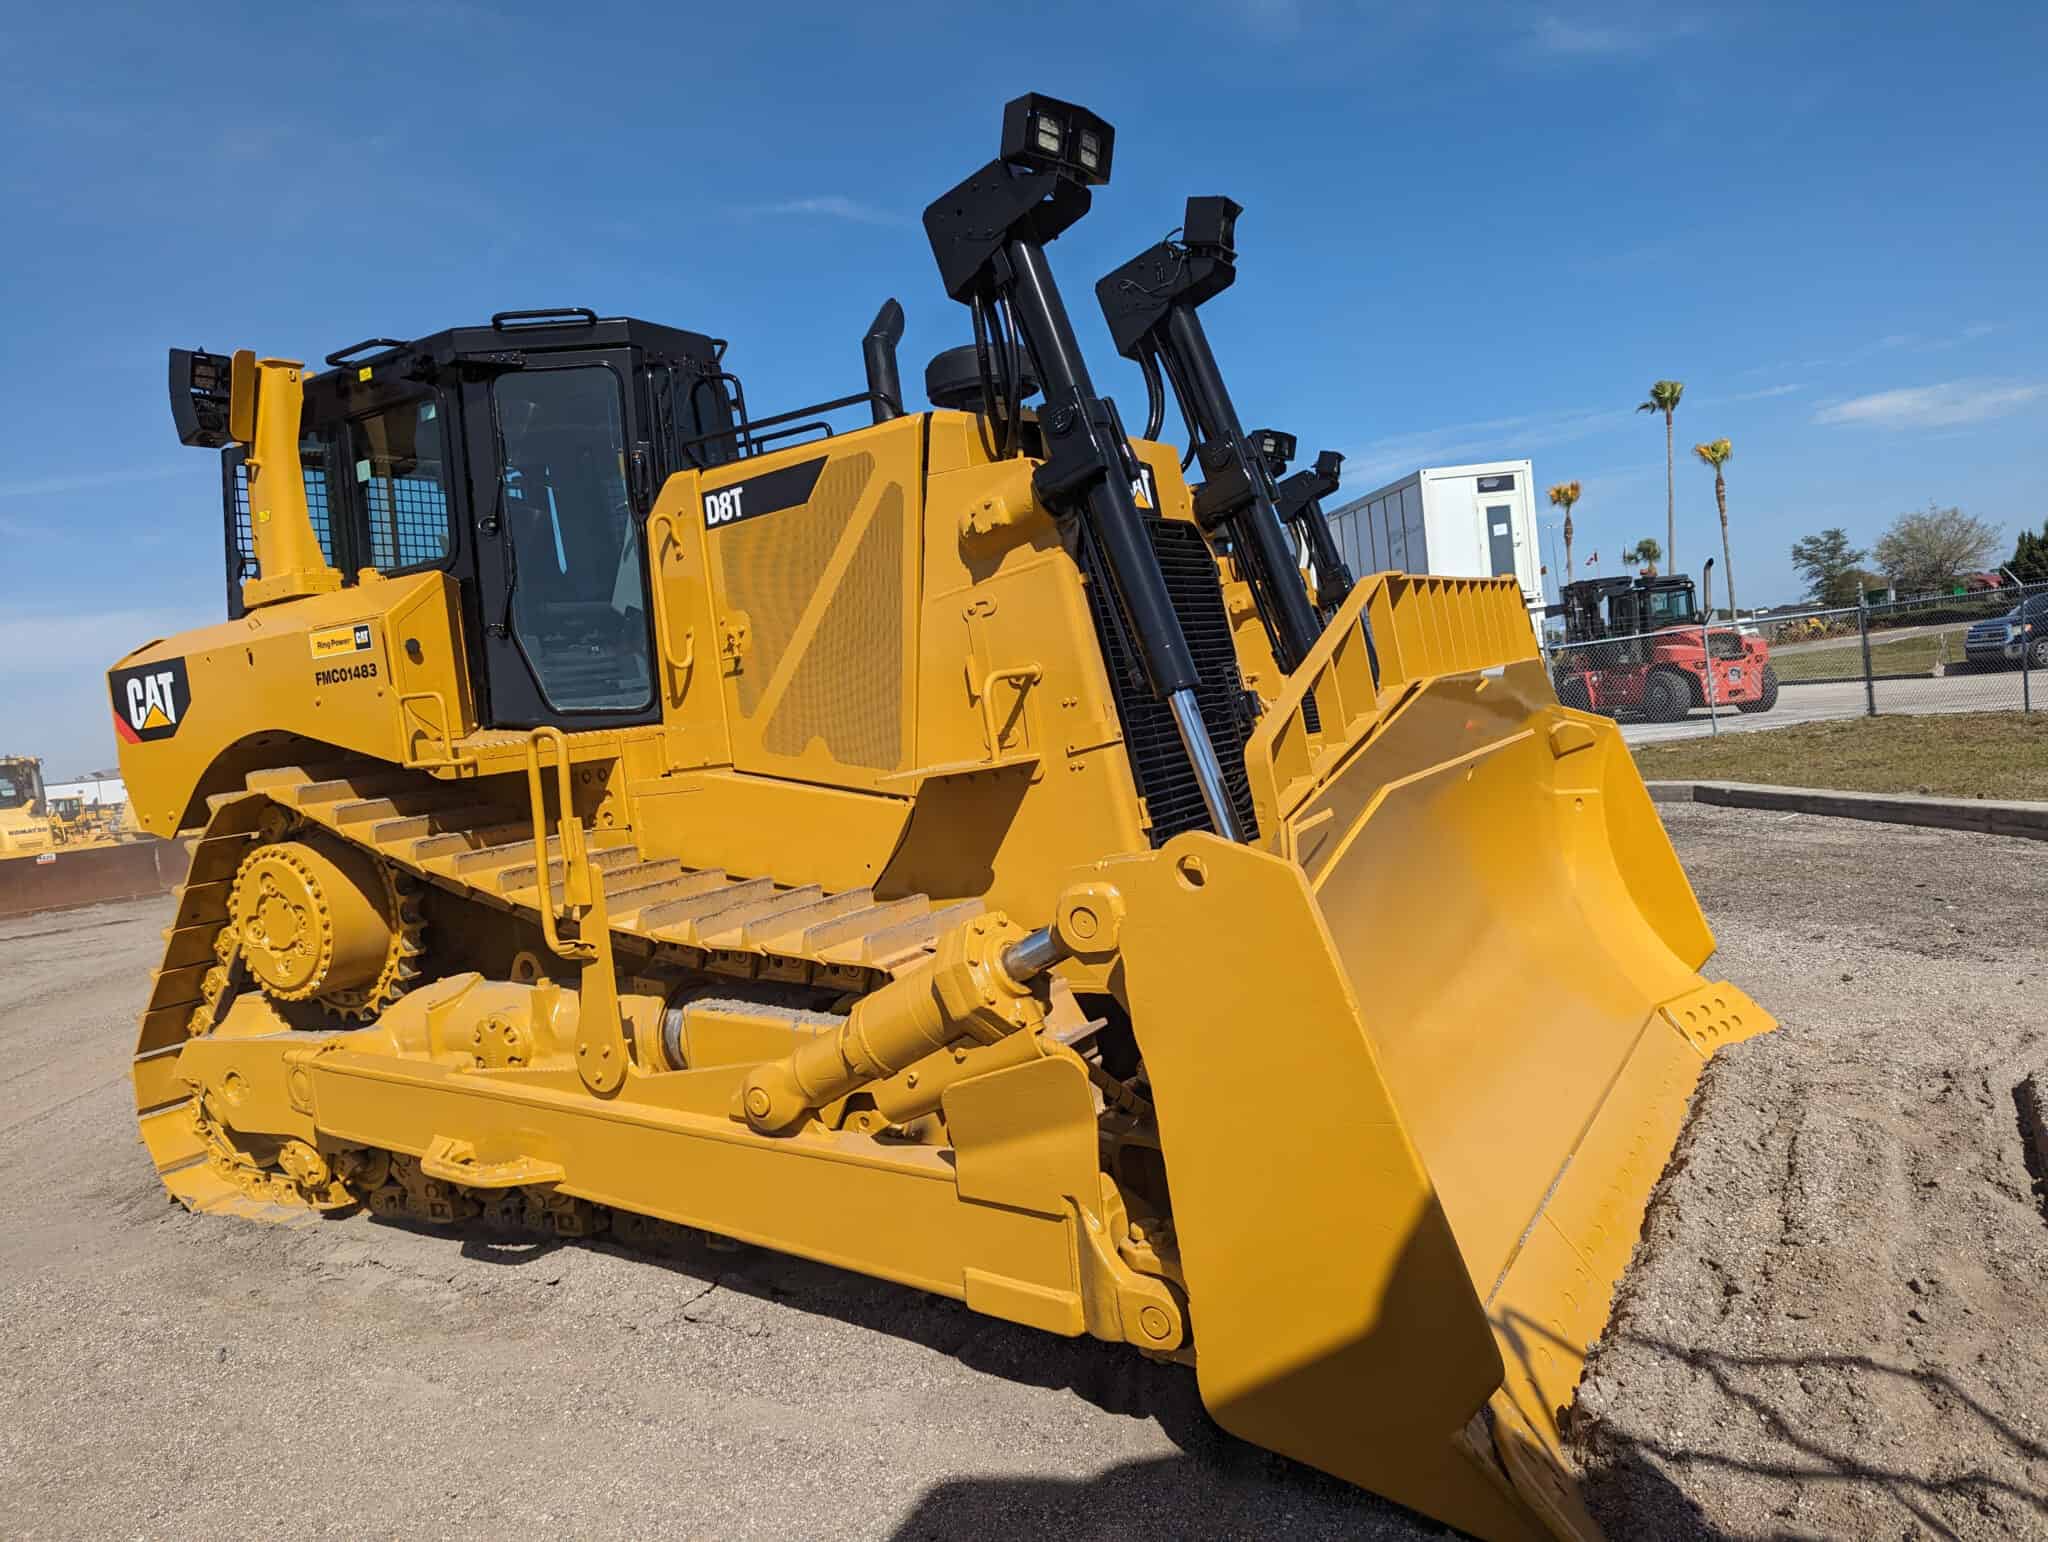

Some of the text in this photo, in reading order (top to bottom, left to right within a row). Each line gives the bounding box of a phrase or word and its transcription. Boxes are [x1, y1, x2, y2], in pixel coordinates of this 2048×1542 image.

[704, 486, 743, 525] D8T
[1129, 468, 1154, 509] AT
[316, 638, 352, 650] Ring Power
[356, 630, 369, 644] CAT
[126, 671, 177, 730] CAT
